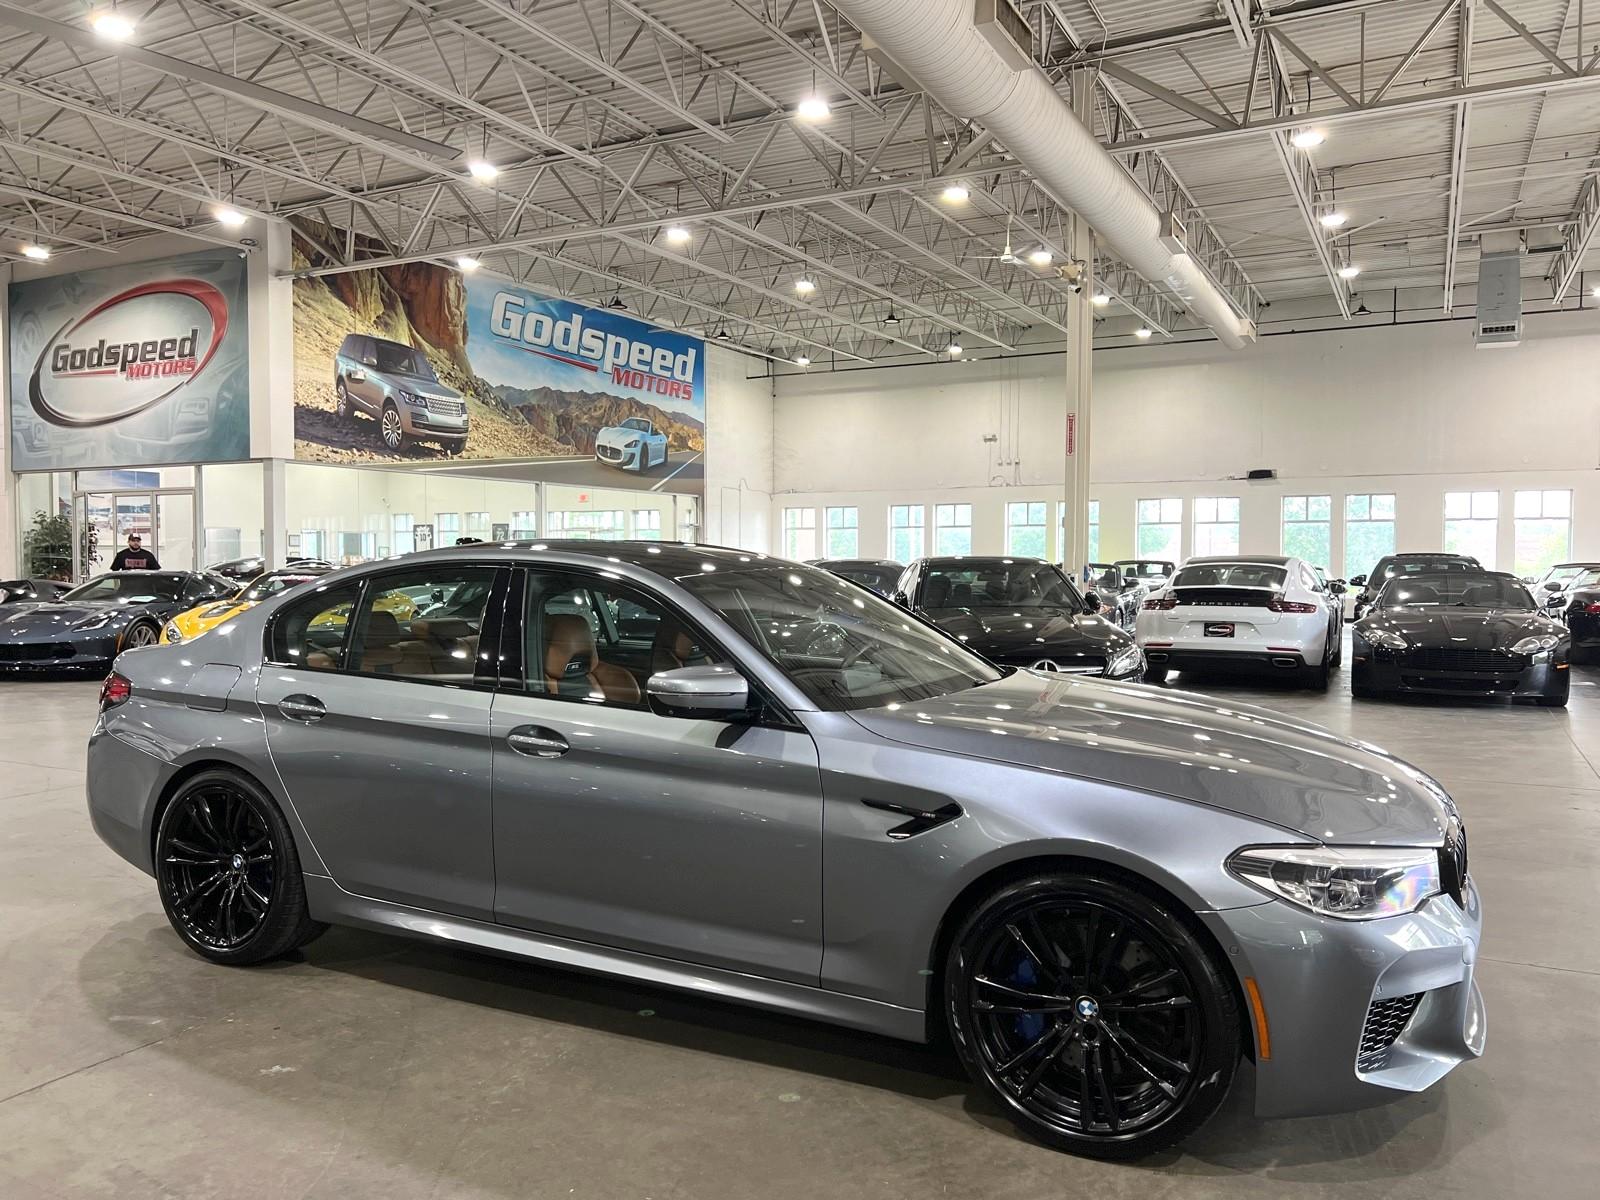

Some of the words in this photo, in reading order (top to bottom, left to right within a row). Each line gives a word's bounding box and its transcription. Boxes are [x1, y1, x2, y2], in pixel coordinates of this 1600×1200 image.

[51, 328, 199, 372] Godspeed
[491, 292, 697, 384] Godspeed
[125, 359, 196, 379] MOTORS
[612, 367, 694, 400] MOTORS
